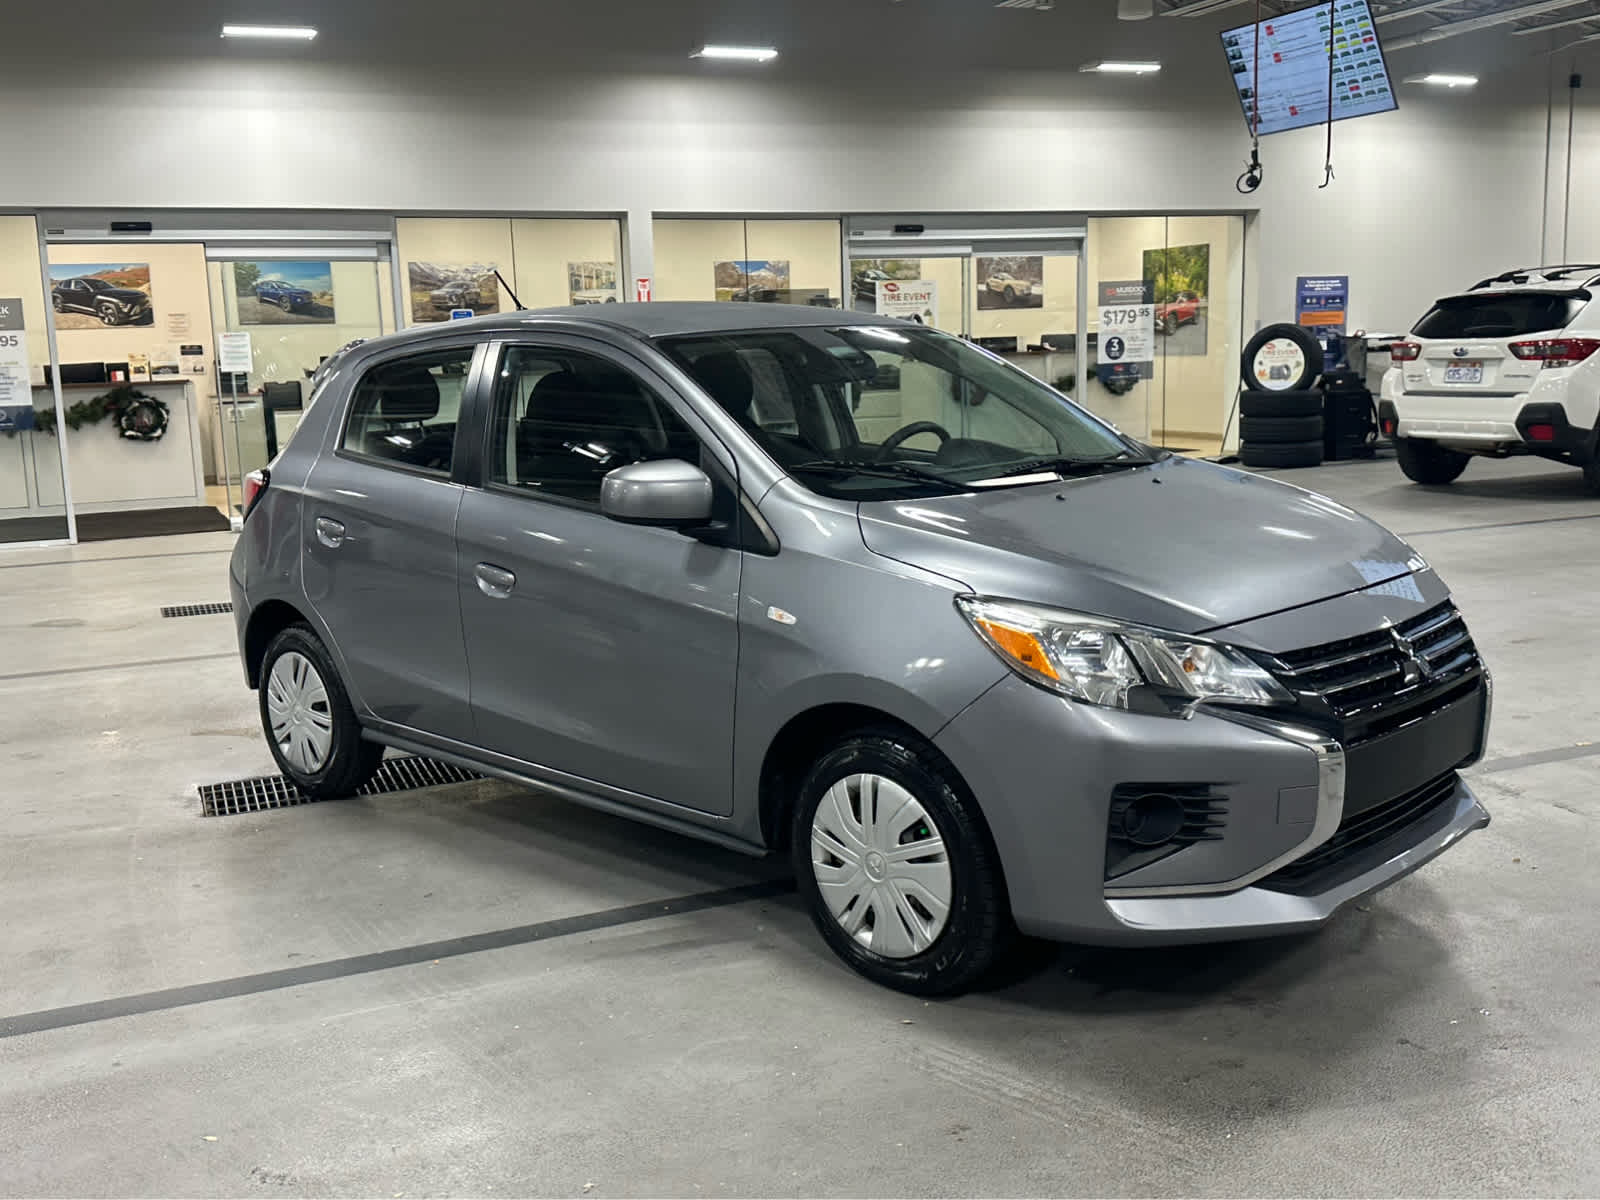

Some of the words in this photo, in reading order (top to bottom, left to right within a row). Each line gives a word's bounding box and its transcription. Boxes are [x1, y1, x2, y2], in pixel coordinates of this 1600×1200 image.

[882, 293, 902, 302] TIRE
[903, 292, 932, 301] EVENT
[1111, 338, 1120, 351] 3
